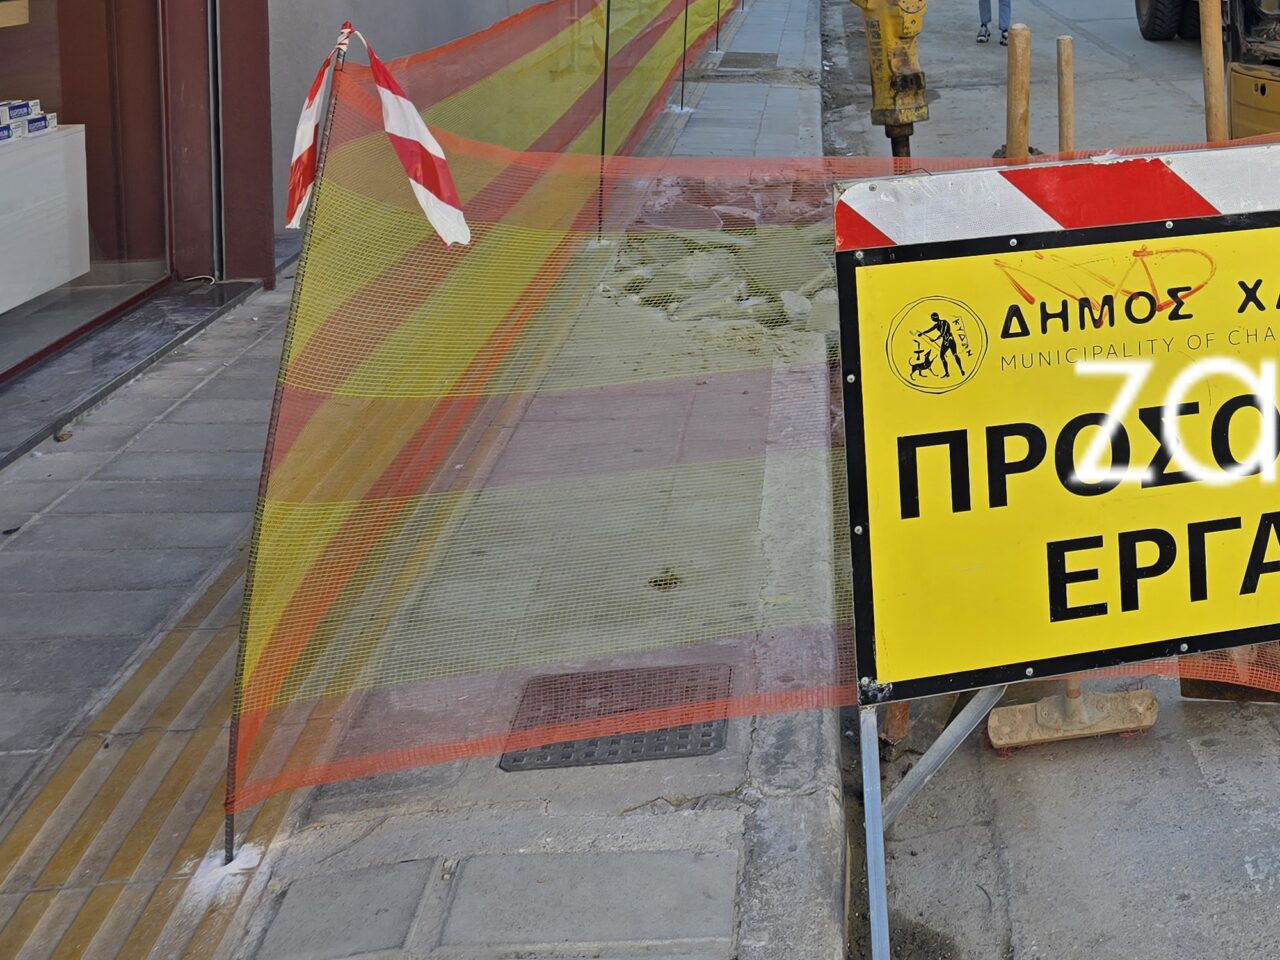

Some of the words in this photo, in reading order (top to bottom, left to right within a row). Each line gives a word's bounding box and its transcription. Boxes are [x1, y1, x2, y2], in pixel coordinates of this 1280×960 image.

[1001, 286, 1194, 339] ΔΗΜΟΣ
[1001, 337, 1174, 371] MUNICIPALITY
[1187, 333, 1216, 350] OF
